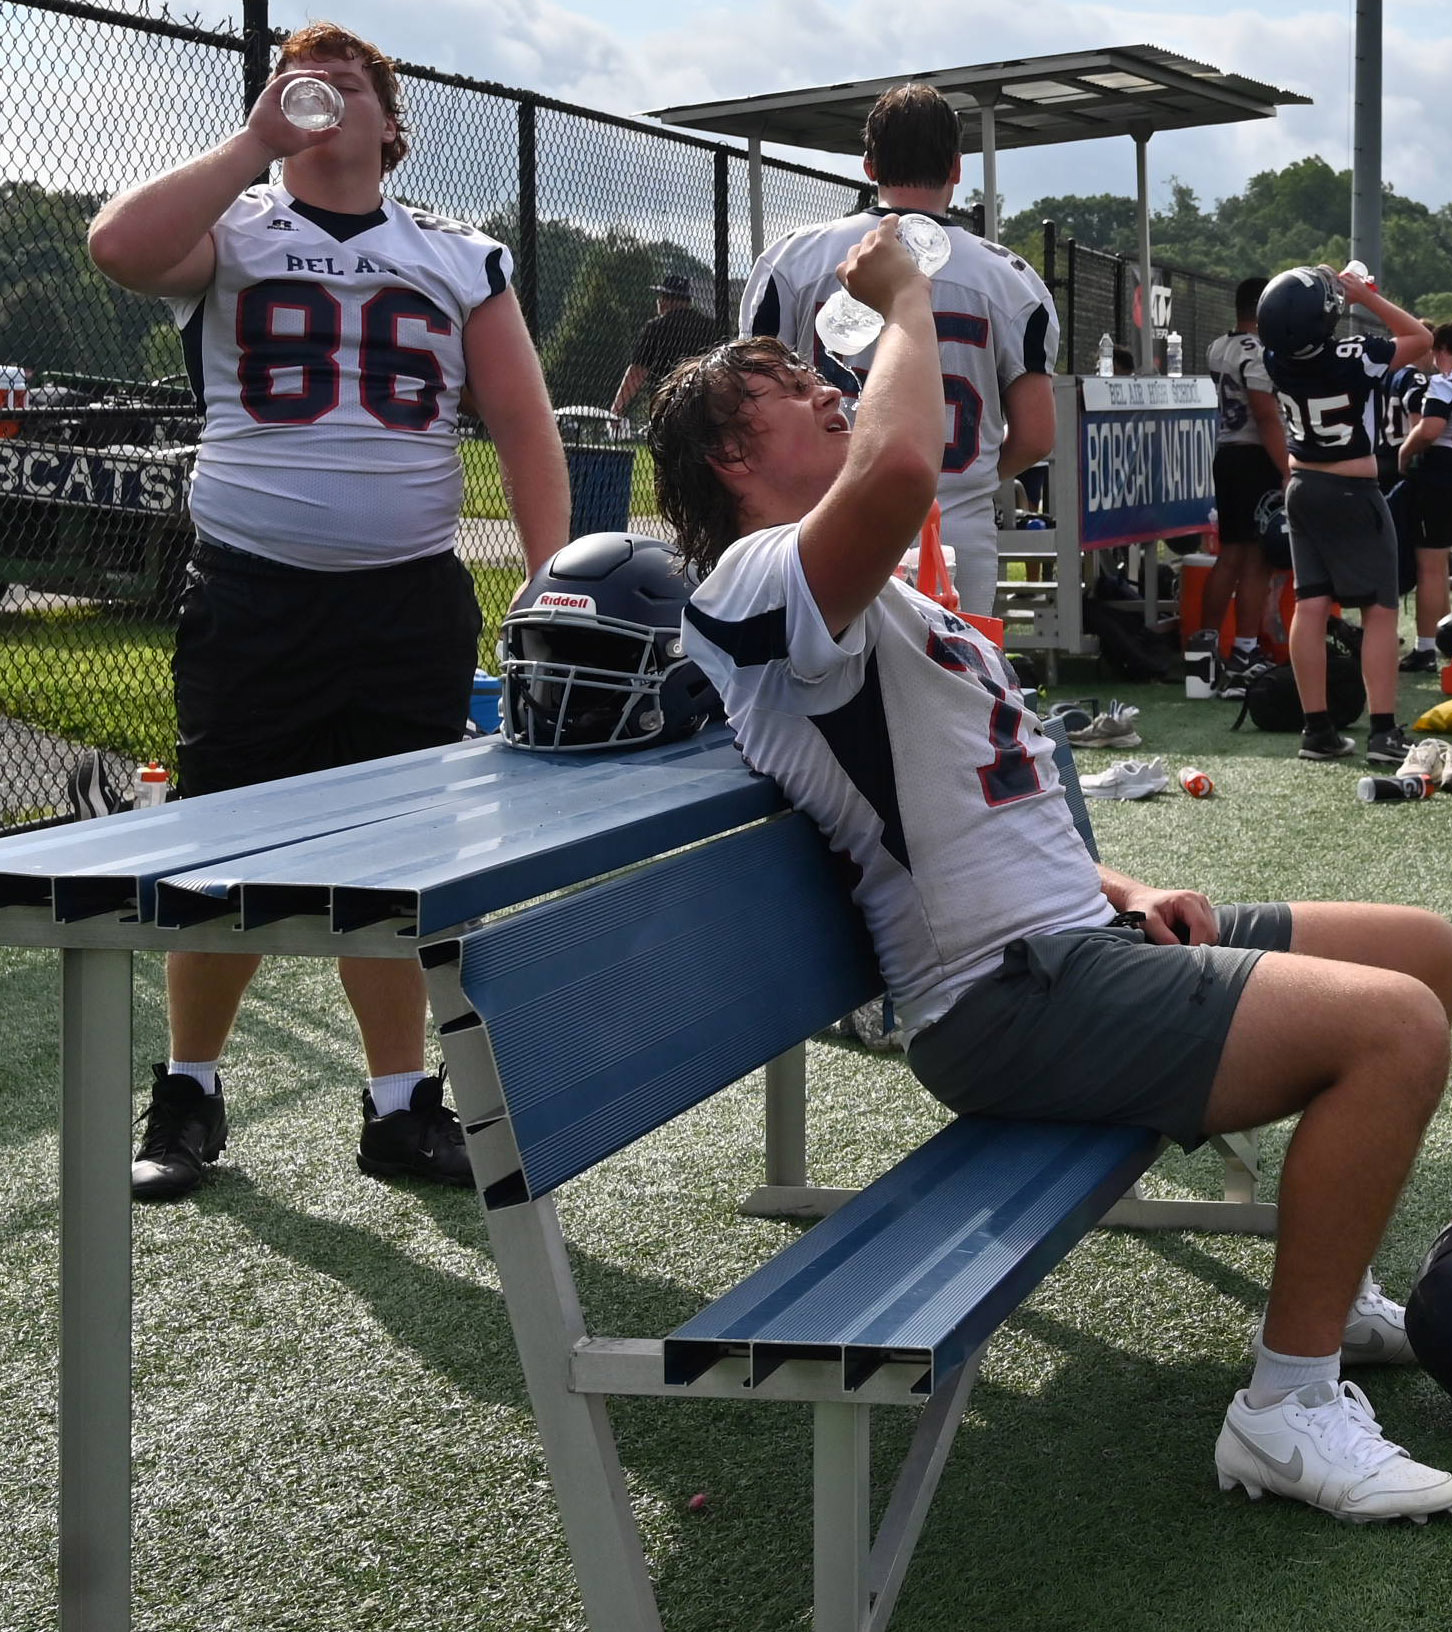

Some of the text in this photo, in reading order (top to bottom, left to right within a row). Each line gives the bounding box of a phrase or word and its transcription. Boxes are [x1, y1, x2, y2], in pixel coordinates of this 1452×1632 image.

[286, 254, 344, 276] BEL
[236, 279, 452, 431] 86
[1109, 384, 1127, 405] BEL
[1128, 383, 1145, 404] AIR
[1087, 419, 1216, 512] BOBCAT NATION
[540, 595, 588, 609] Riddell
